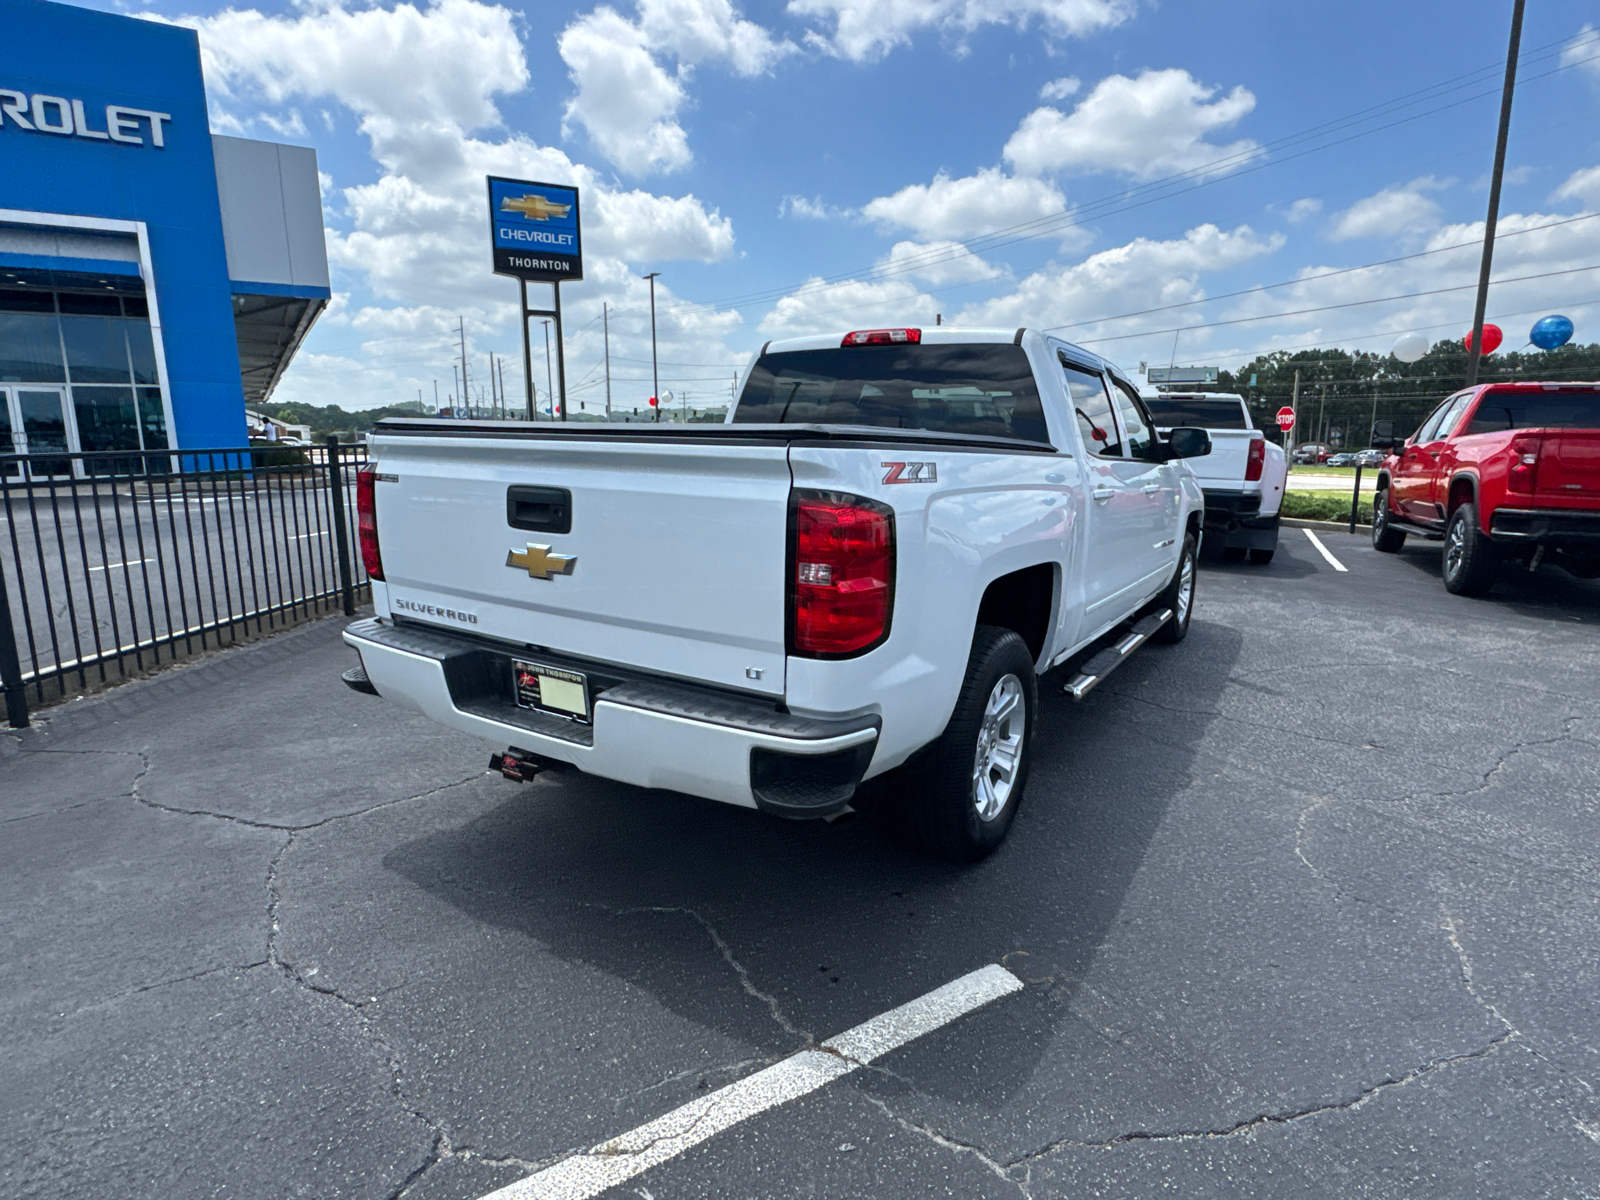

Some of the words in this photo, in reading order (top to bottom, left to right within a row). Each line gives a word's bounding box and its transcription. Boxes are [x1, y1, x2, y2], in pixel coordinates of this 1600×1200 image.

[499, 228, 574, 245] CHEVROLET
[508, 257, 570, 271] THORNTON
[1277, 414, 1294, 425] STOP
[881, 462, 937, 485] Z71
[396, 599, 478, 624] SILVERADO
[527, 665, 545, 674] JOHN
[545, 669, 582, 683] THORNTON
